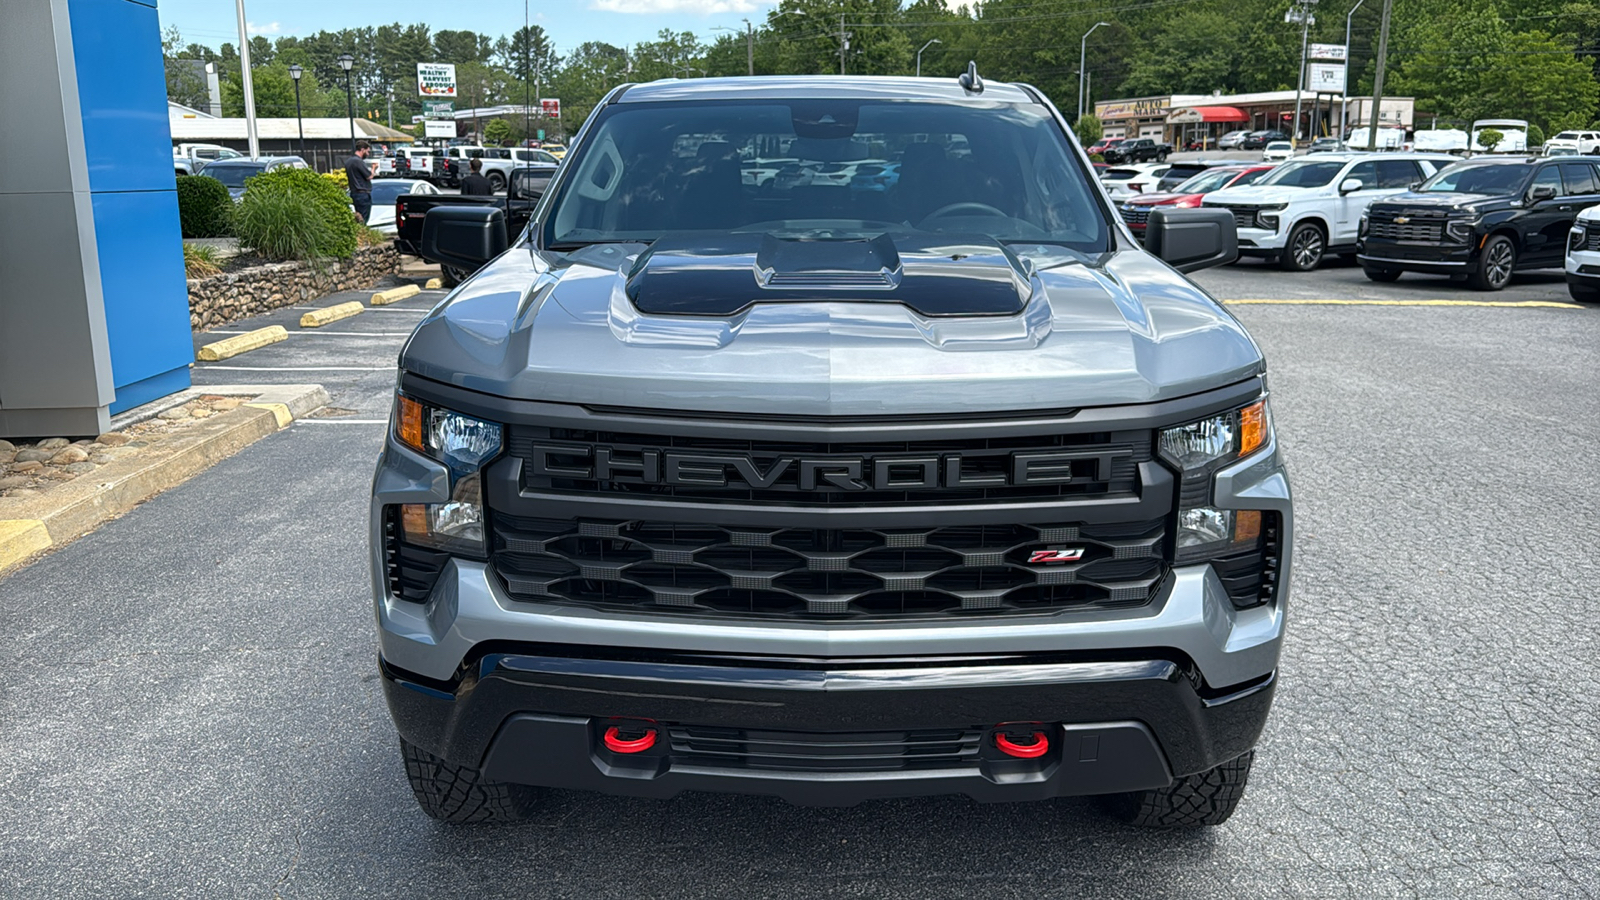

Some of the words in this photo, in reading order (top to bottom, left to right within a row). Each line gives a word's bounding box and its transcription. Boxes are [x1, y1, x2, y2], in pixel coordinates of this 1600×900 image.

[1135, 100, 1162, 109] AUTO
[1133, 107, 1161, 117] MART
[532, 444, 1133, 491] CHEVROLET
[1027, 549, 1085, 562] Z71
